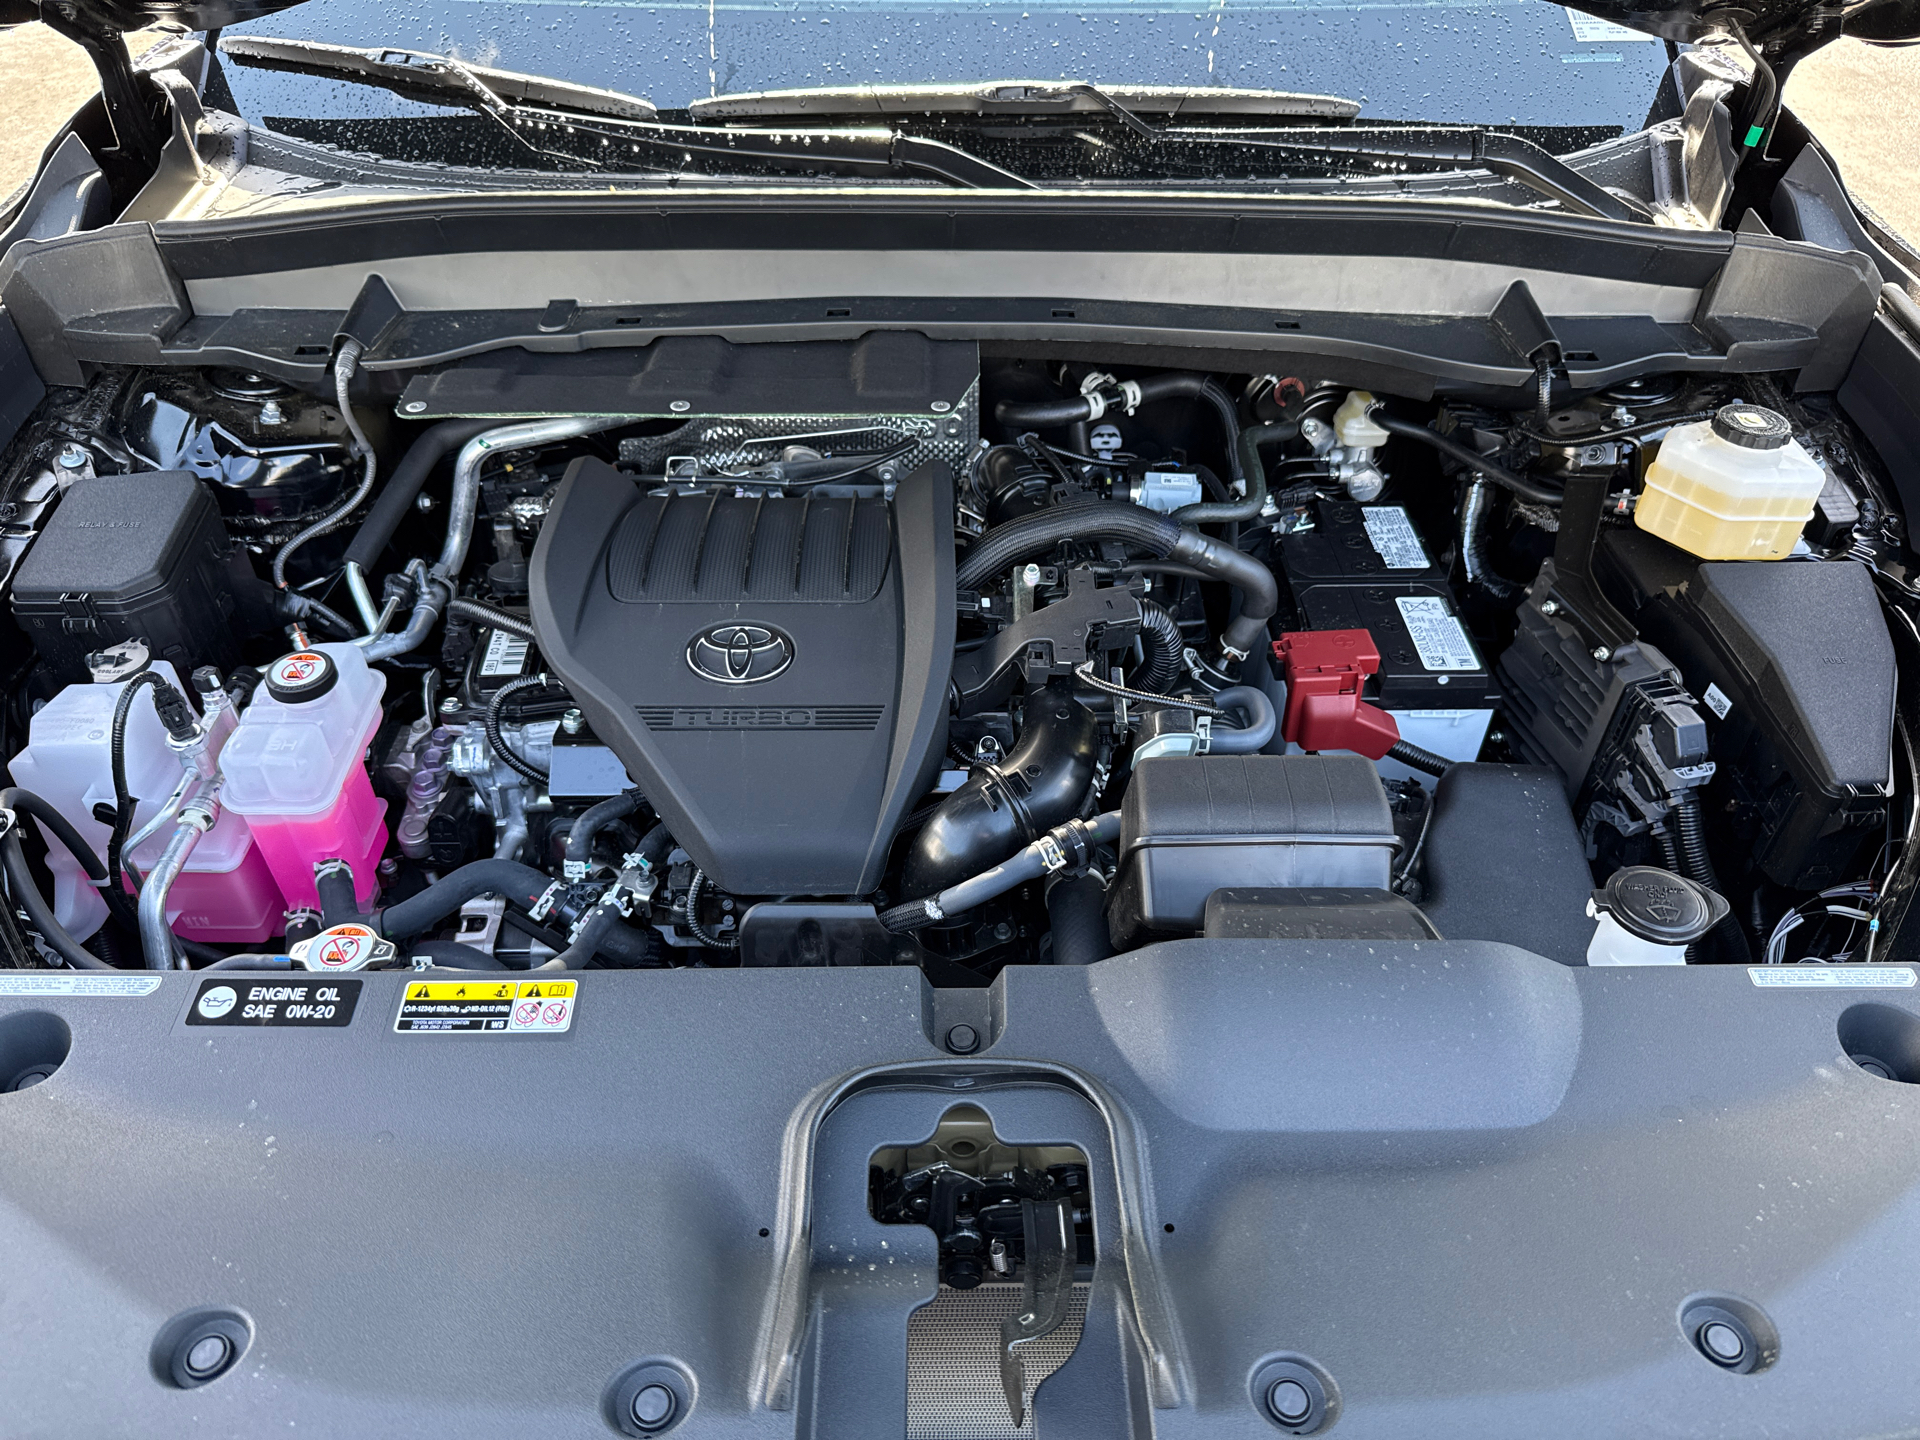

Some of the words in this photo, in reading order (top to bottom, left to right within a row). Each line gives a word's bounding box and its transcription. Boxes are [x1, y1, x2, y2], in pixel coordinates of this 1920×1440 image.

[1822, 656, 1848, 665] FUSE
[677, 708, 813, 726] TURBO
[1625, 882, 1660, 892] WASHER
[1647, 890, 1668, 899] ONLY
[181, 916, 211, 927] MIN
[248, 986, 308, 1001] ENGINE
[315, 987, 341, 1001] OIL
[242, 1003, 277, 1018] SAE
[285, 1004, 336, 1019] 0W-20
